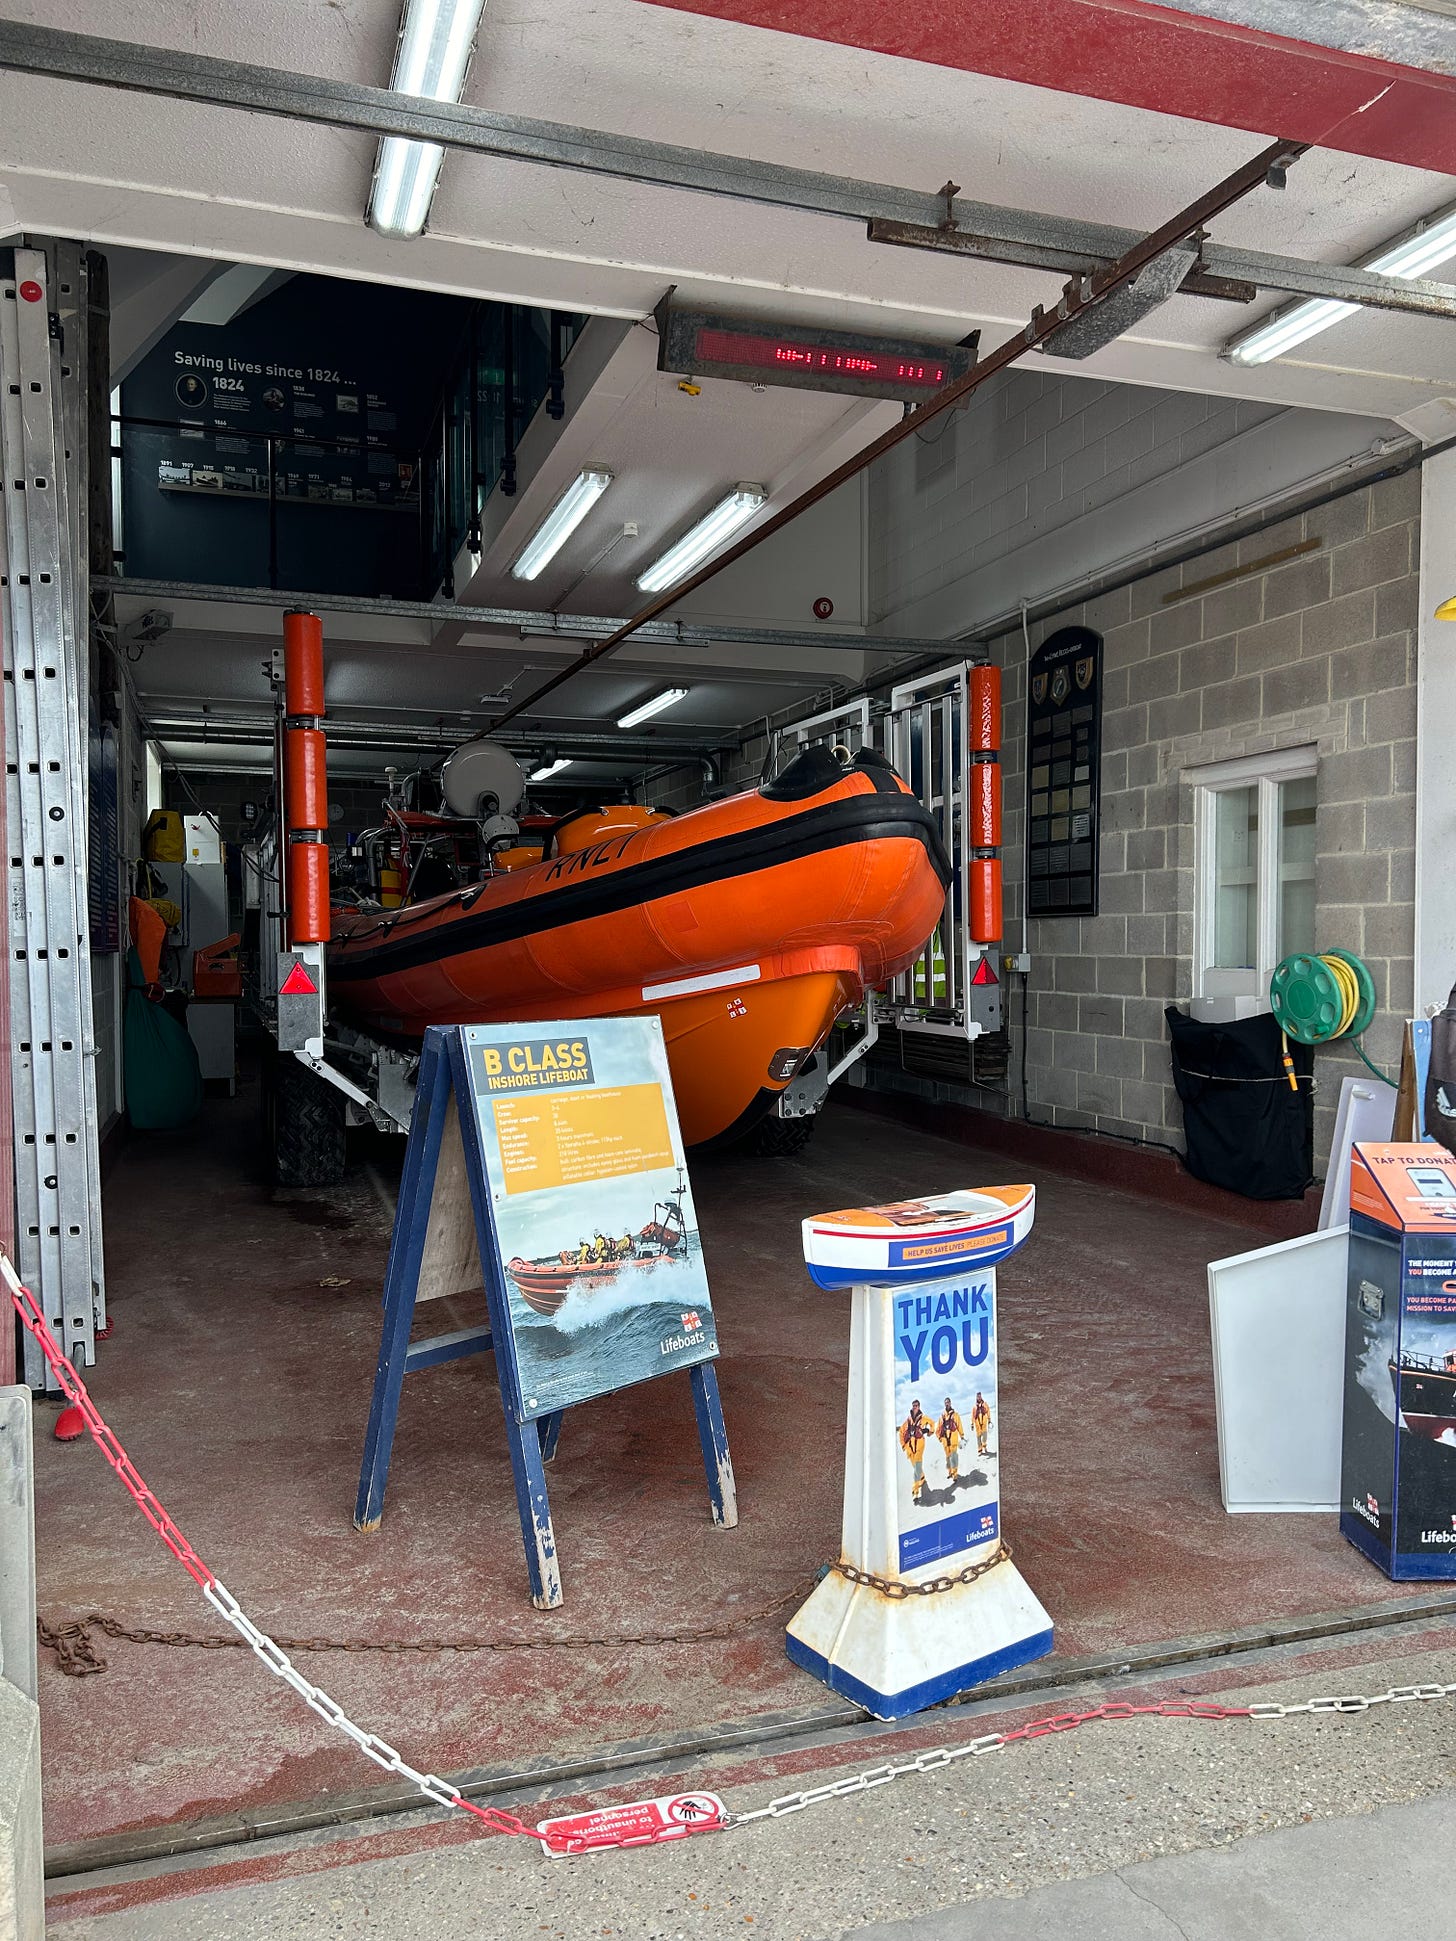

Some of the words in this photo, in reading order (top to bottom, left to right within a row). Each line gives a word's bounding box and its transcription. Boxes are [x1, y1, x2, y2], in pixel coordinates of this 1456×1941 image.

[174, 351, 224, 372] Saving
[228, 357, 262, 375] lives
[265, 363, 303, 379] since
[307, 367, 341, 384] 1824
[212, 376, 245, 392] 1824
[482, 1048, 503, 1076] B
[507, 1042, 588, 1074] CLASS
[487, 1072, 539, 1090] INSHORE
[539, 1068, 589, 1085] LIFEBOAT
[1372, 1157, 1396, 1165] TAP
[907, 1248, 924, 1257] HELP
[925, 1247, 933, 1255] US
[934, 1245, 948, 1253] SAVE
[949, 1242, 965, 1251] LIVES
[898, 1283, 988, 1330] THANK
[661, 1331, 705, 1355] Lifeboats
[900, 1316, 989, 1384] YOU
[1352, 1497, 1380, 1529] Lifeboats
[966, 1527, 995, 1543] Lifeboats
[589, 1806, 649, 1825] personnel
[640, 1816, 653, 1824] to
